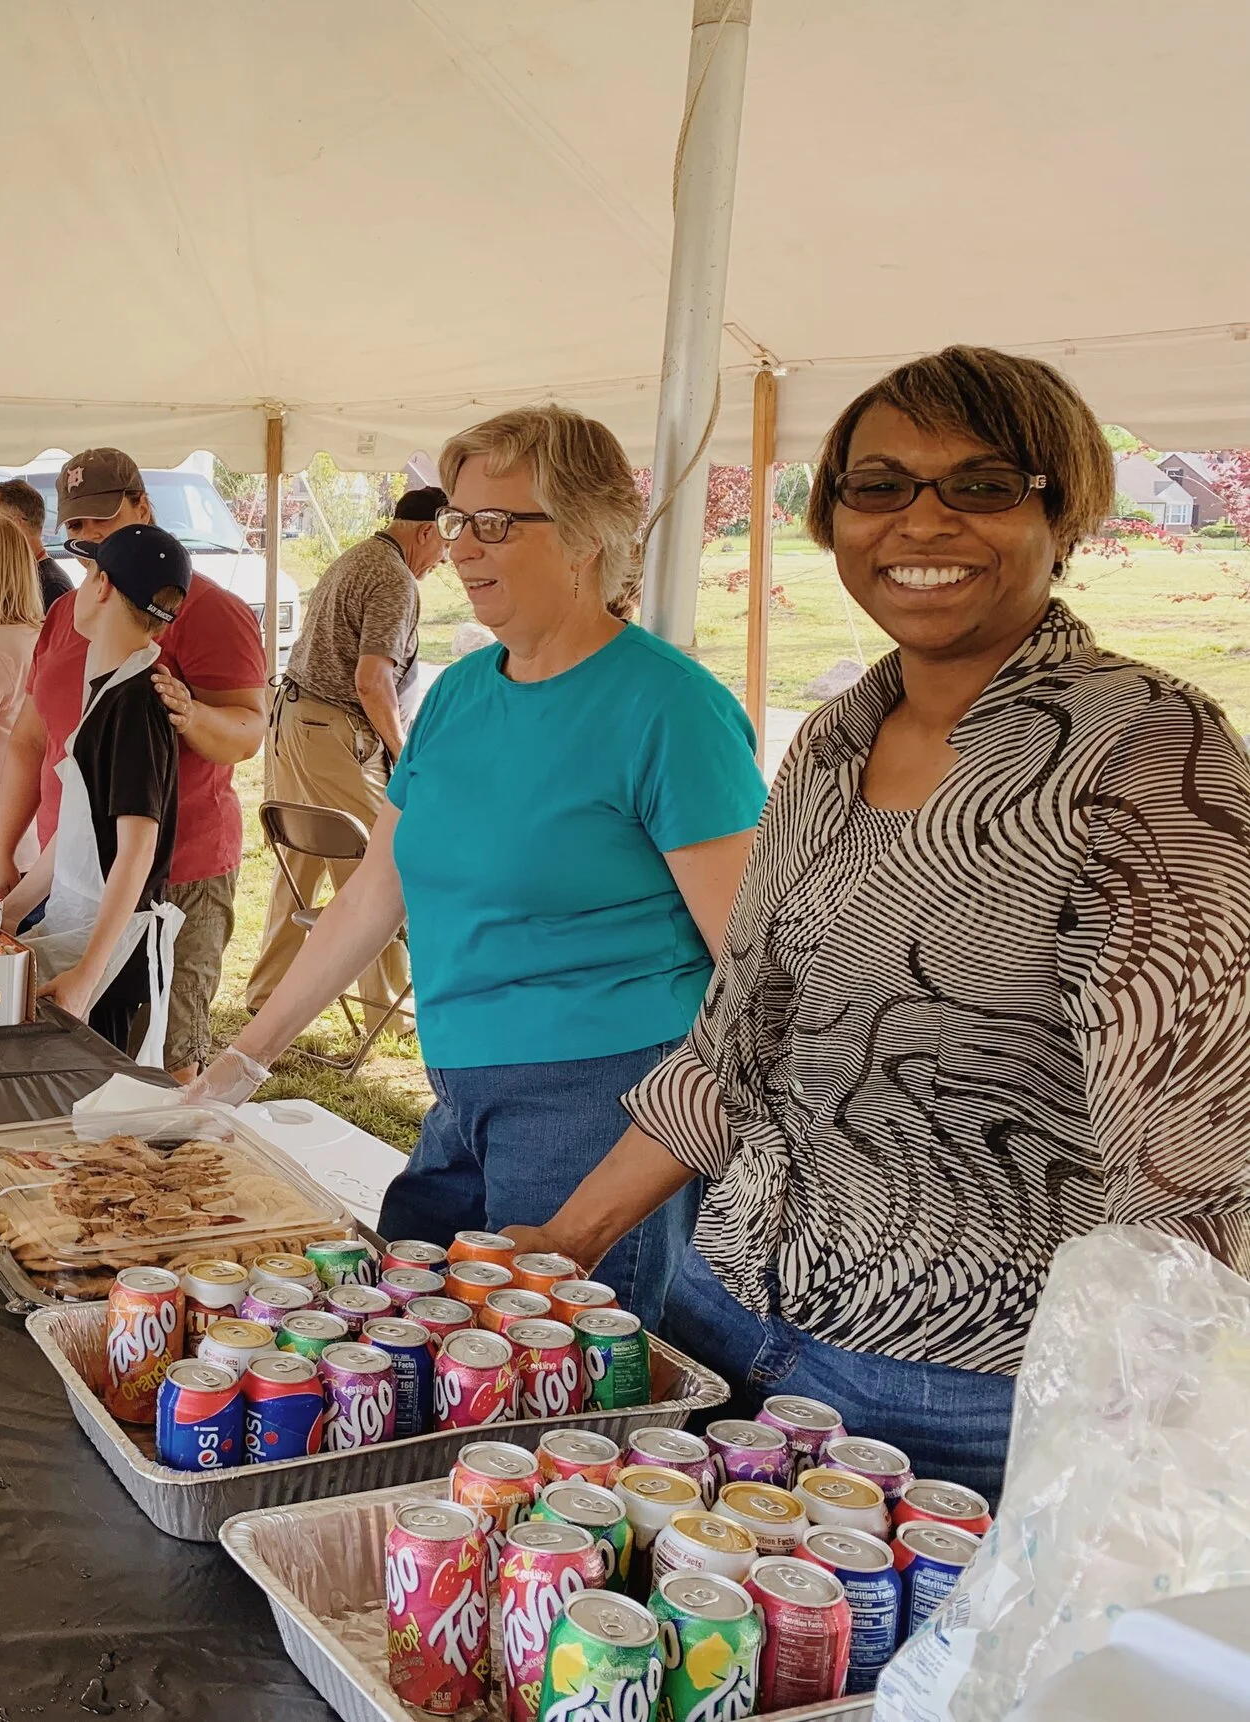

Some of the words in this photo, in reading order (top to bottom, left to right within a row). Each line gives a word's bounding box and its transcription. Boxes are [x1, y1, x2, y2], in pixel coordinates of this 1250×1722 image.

[398, 1361, 415, 1369] Facts
[400, 1381, 414, 1389] 160
[520, 1357, 577, 1419] ygo
[245, 1409, 267, 1464] epsi
[193, 1425, 223, 1468] psi
[756, 1537, 776, 1546] rition
[777, 1537, 796, 1546] Facts
[683, 1552, 702, 1569] Facts
[428, 1557, 489, 1677] Fay
[782, 1615, 807, 1627] Nutrition
[807, 1618, 823, 1628] Facts
